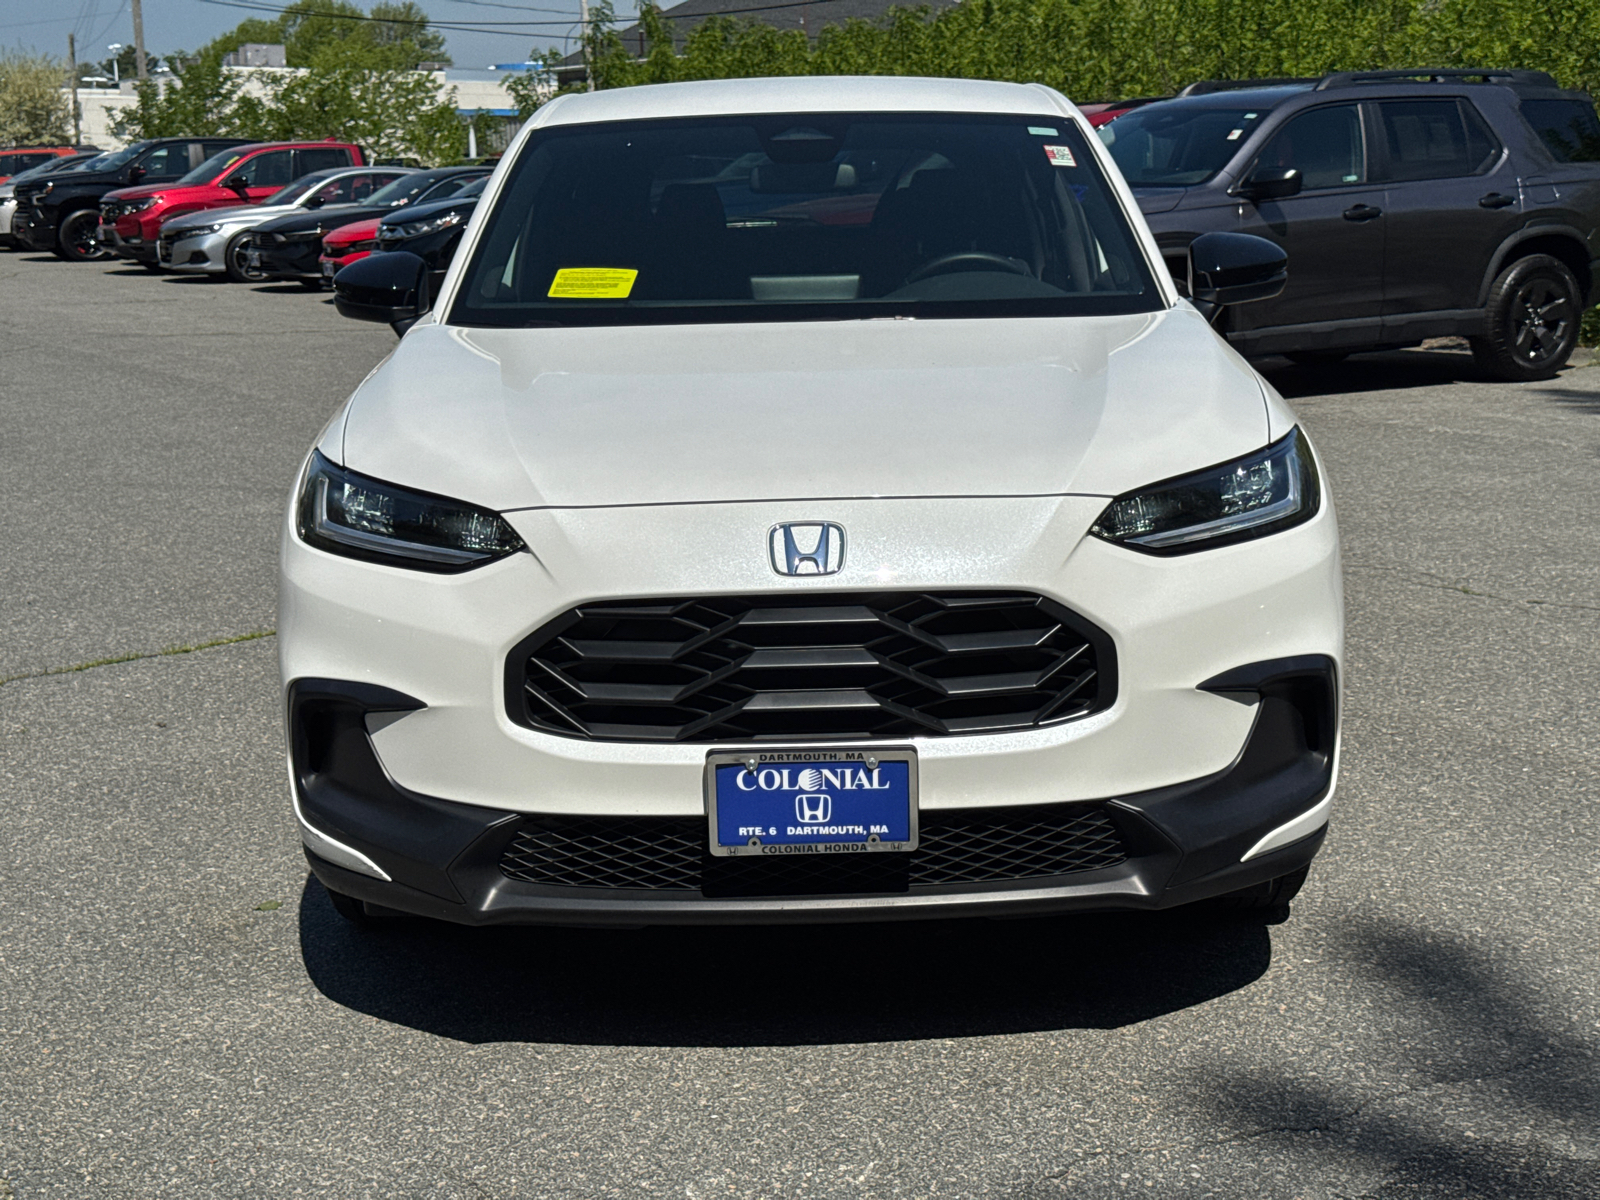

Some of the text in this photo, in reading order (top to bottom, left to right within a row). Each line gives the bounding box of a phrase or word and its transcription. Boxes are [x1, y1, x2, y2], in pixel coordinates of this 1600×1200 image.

[759, 752, 865, 762] DARTMOUTH, MA
[736, 768, 890, 791] COLONIAL
[739, 825, 889, 836] RTE. 6 DARTMOUTH, MA
[761, 843, 868, 854] COLONIAL HONDA
